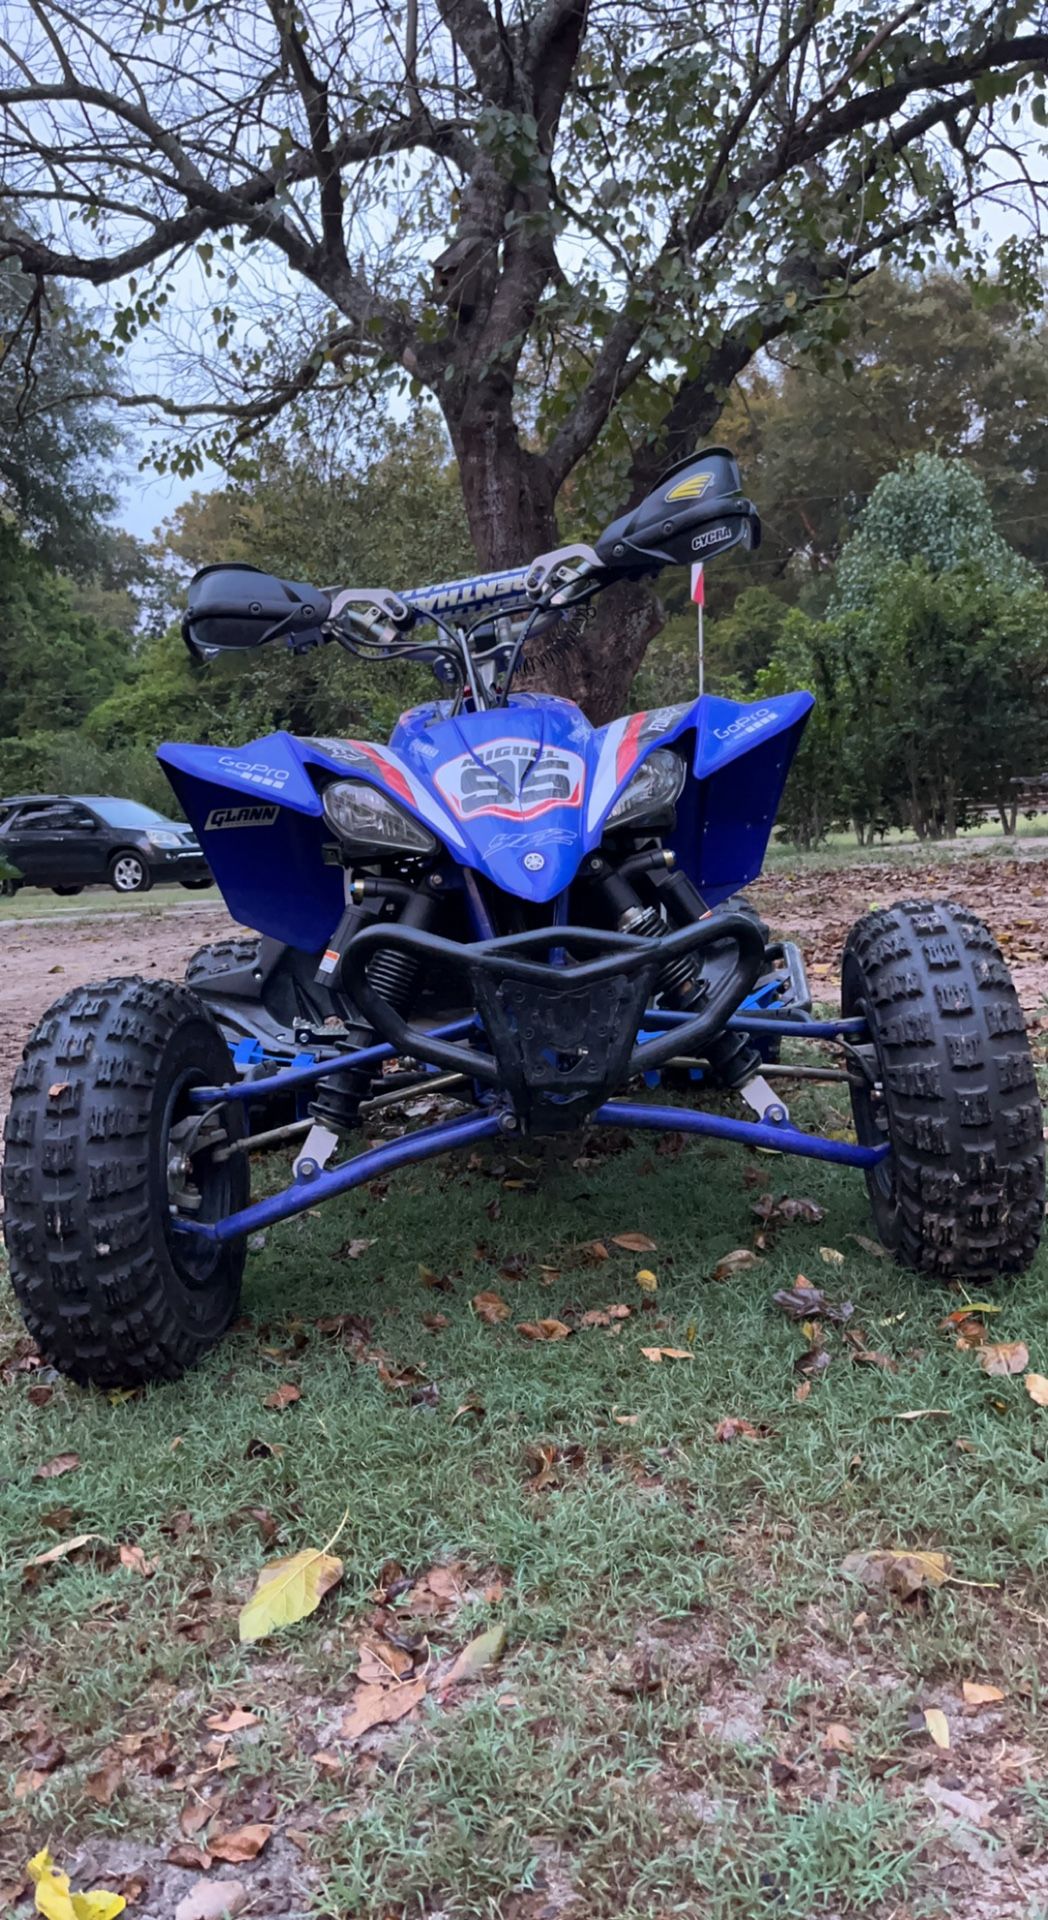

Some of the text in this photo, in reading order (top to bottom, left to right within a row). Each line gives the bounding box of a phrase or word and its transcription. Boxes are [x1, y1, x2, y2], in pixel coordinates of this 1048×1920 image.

[692, 526, 732, 551] CYCRA
[713, 707, 770, 739] GoPro
[218, 756, 290, 780] GoPro
[461, 746, 559, 768] MIGUEL
[460, 758, 571, 813] 95
[211, 806, 276, 826] GLANN
